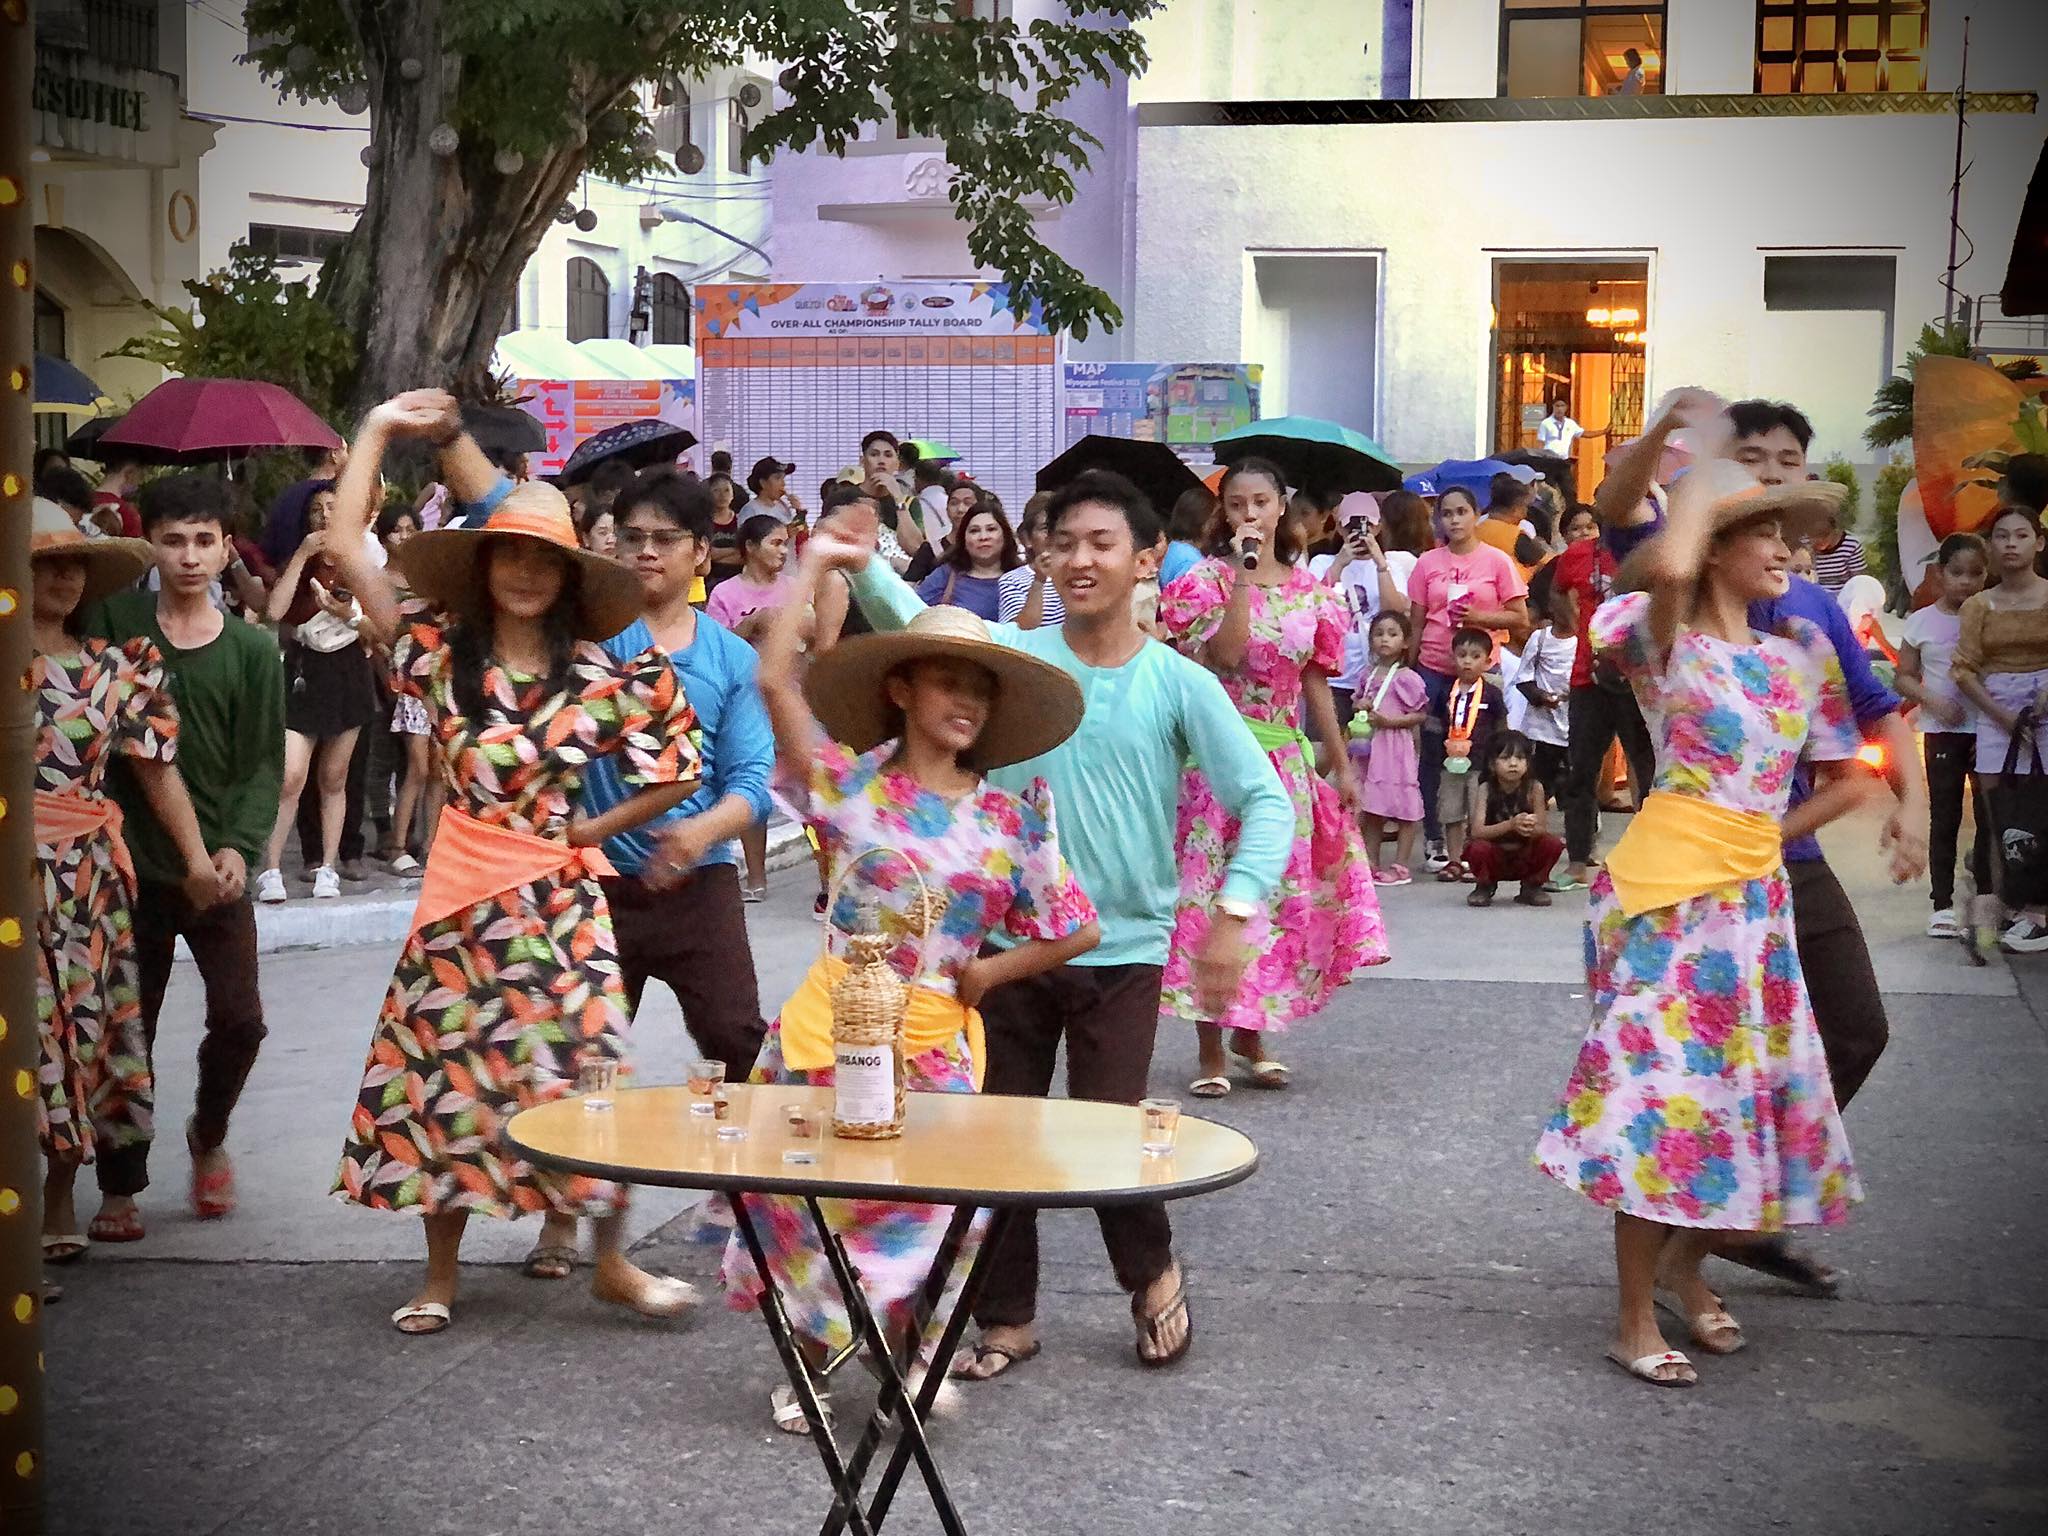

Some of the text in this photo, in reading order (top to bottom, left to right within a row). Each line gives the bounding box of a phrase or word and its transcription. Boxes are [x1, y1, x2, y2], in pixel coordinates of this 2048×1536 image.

[65, 77, 151, 132] OFFICE
[771, 318, 983, 329] OVER-ALL CHAMPIONSHIP TALLY BOARD
[1073, 363, 1106, 375] MAP
